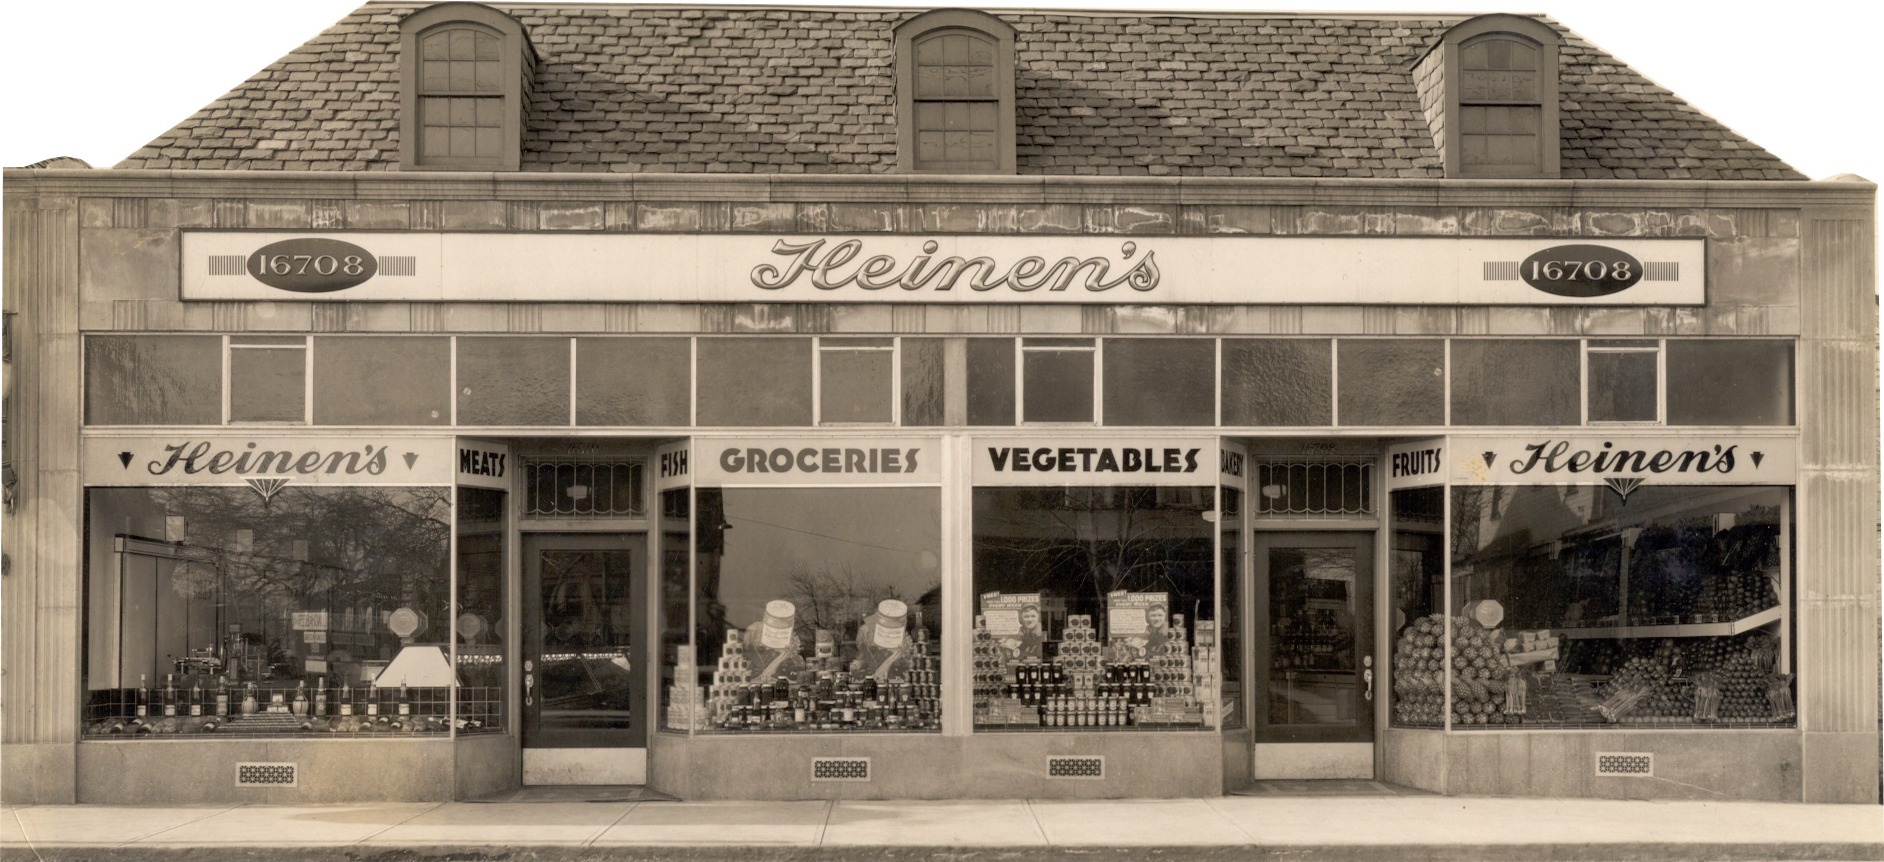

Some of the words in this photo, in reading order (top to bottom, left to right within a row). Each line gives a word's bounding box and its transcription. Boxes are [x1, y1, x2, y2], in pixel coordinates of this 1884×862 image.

[259, 255, 364, 275] 16708
[750, 238, 1161, 291] Heinen's
[1532, 260, 1631, 280] 16708
[148, 441, 388, 476] Heinen's
[459, 449, 506, 478] MEATS
[660, 449, 688, 478] FISH
[719, 447, 920, 473] GROCERIES
[987, 447, 1202, 473] VEGETABLES
[1220, 449, 1243, 478] BAKERY
[1391, 448, 1443, 477] FRUITS
[1509, 440, 1739, 475] Heinen's
[1017, 595, 1040, 603] PRIZES
[1144, 594, 1167, 602] PRIZES
